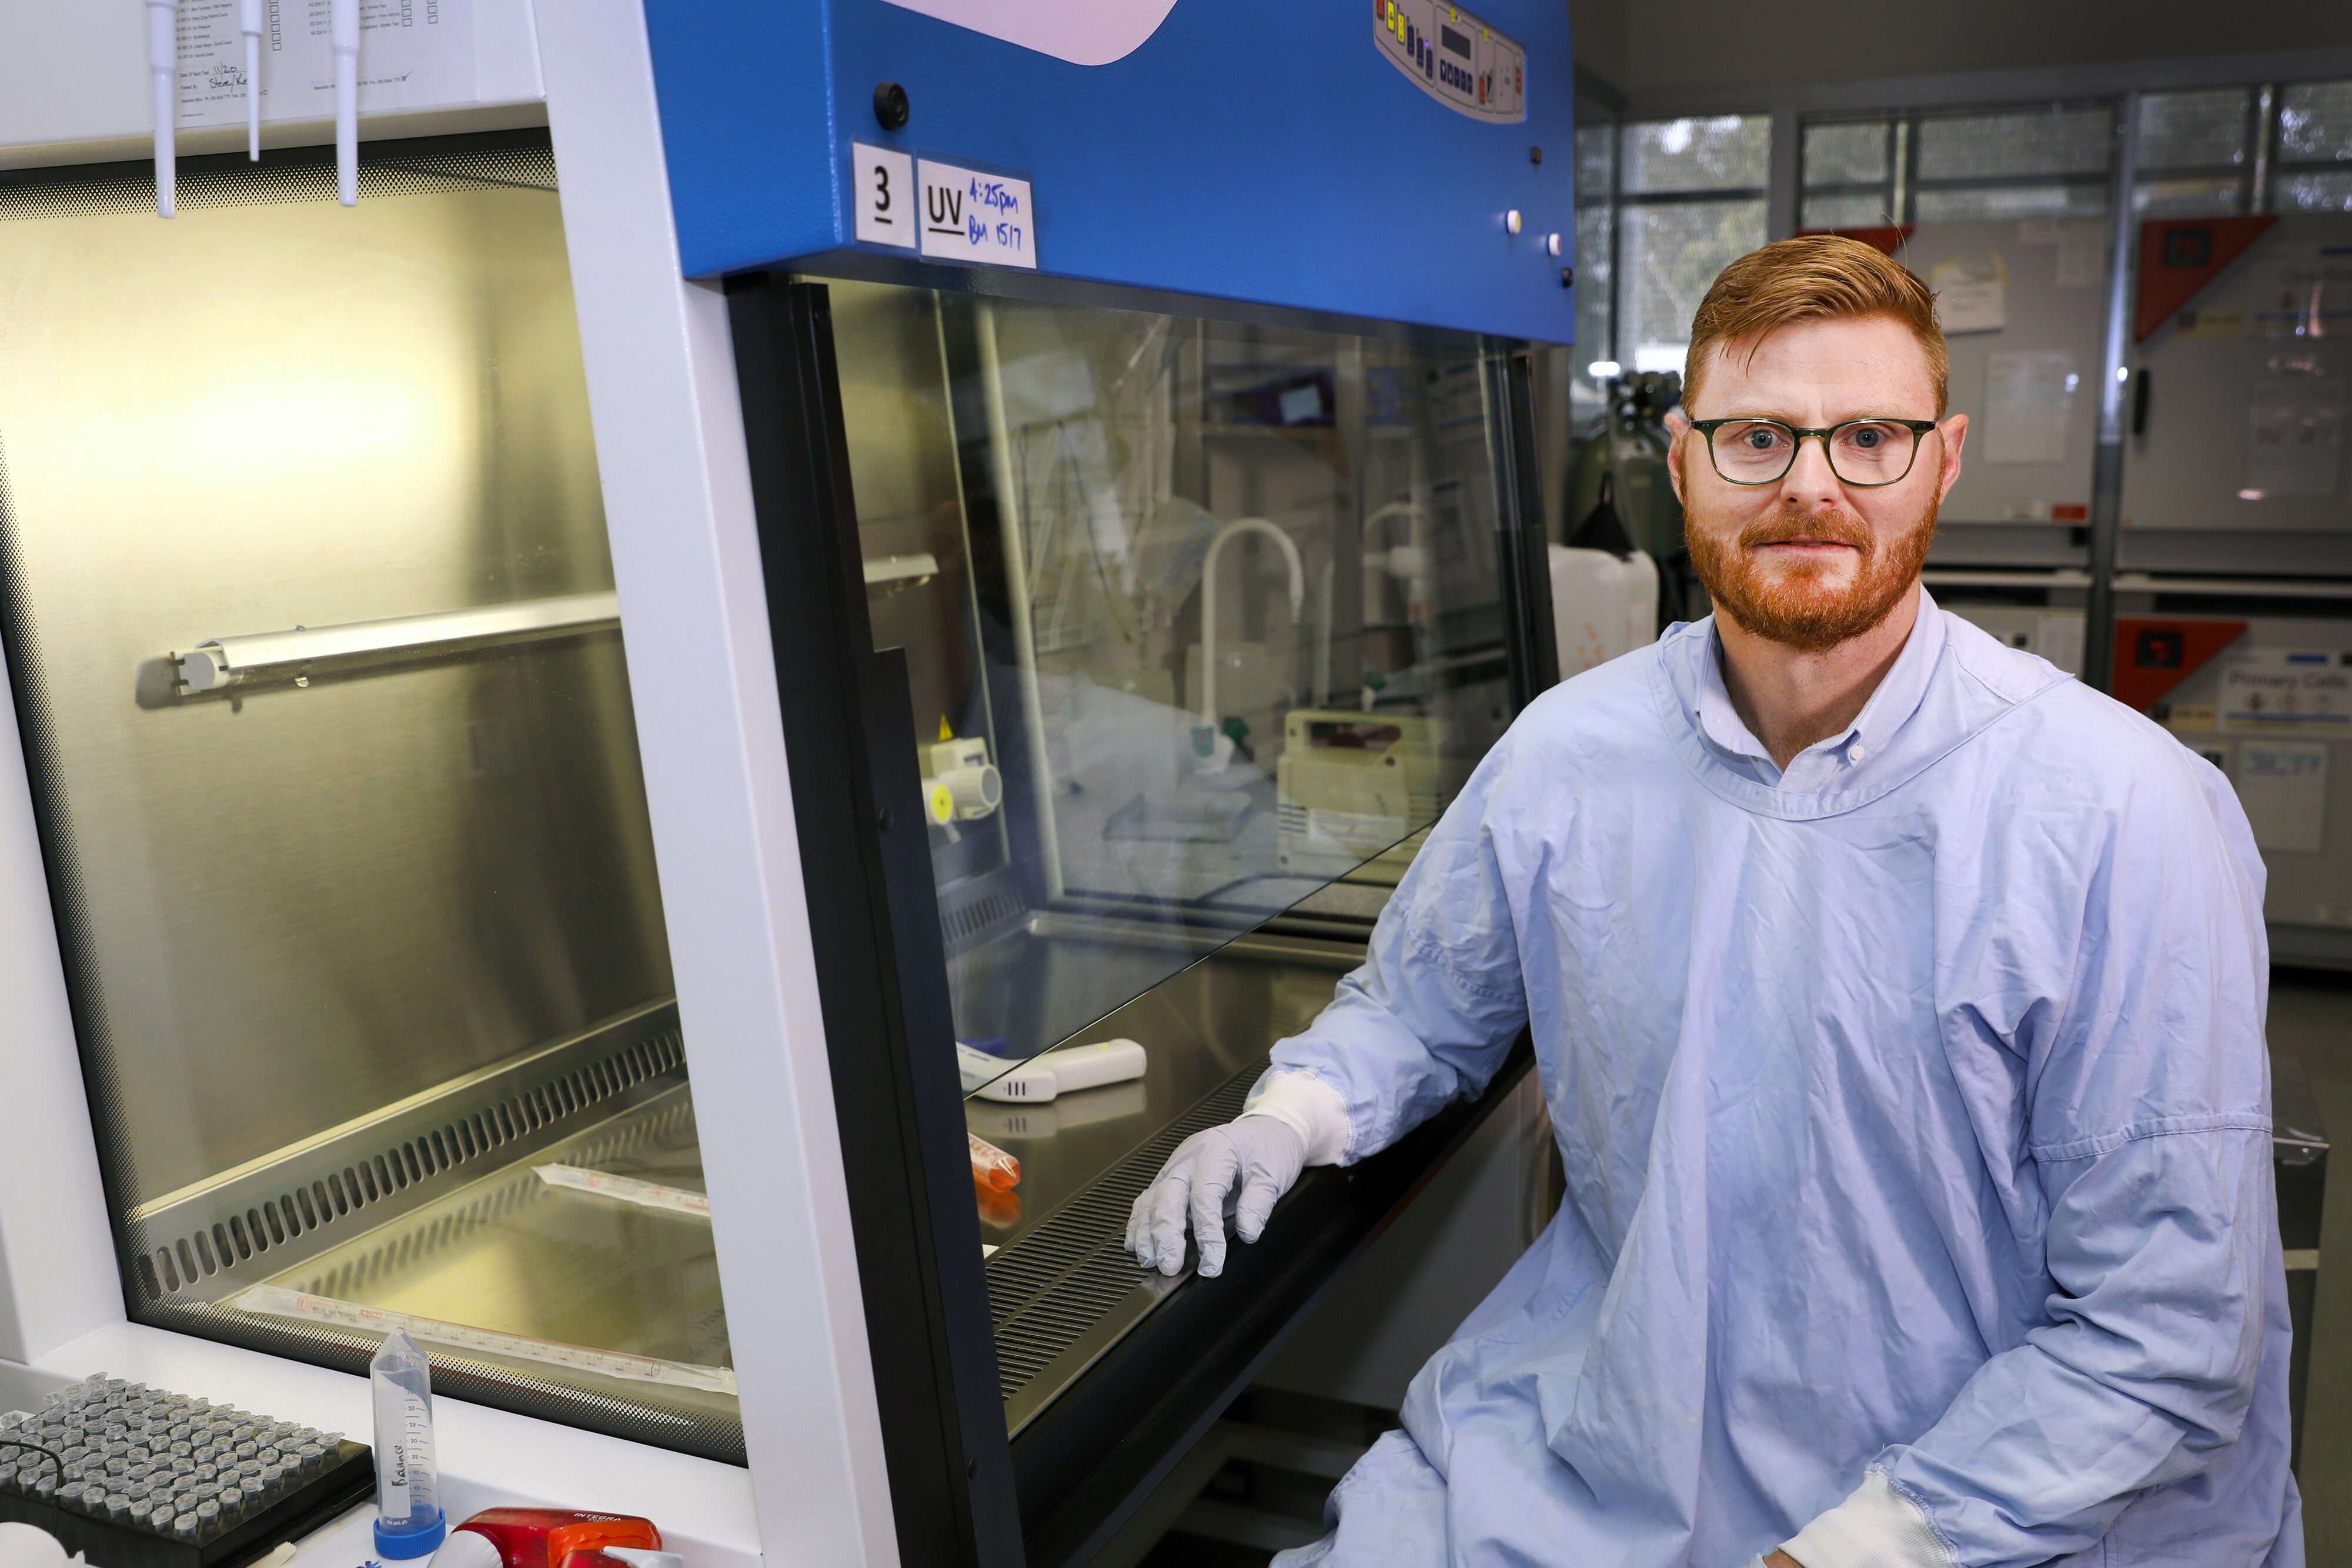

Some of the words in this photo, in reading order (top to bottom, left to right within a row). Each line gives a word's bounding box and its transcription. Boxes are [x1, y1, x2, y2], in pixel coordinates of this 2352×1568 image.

[874, 166, 890, 212] 3
[928, 185, 962, 225] UV
[574, 1513, 621, 1521] INTEGRA
